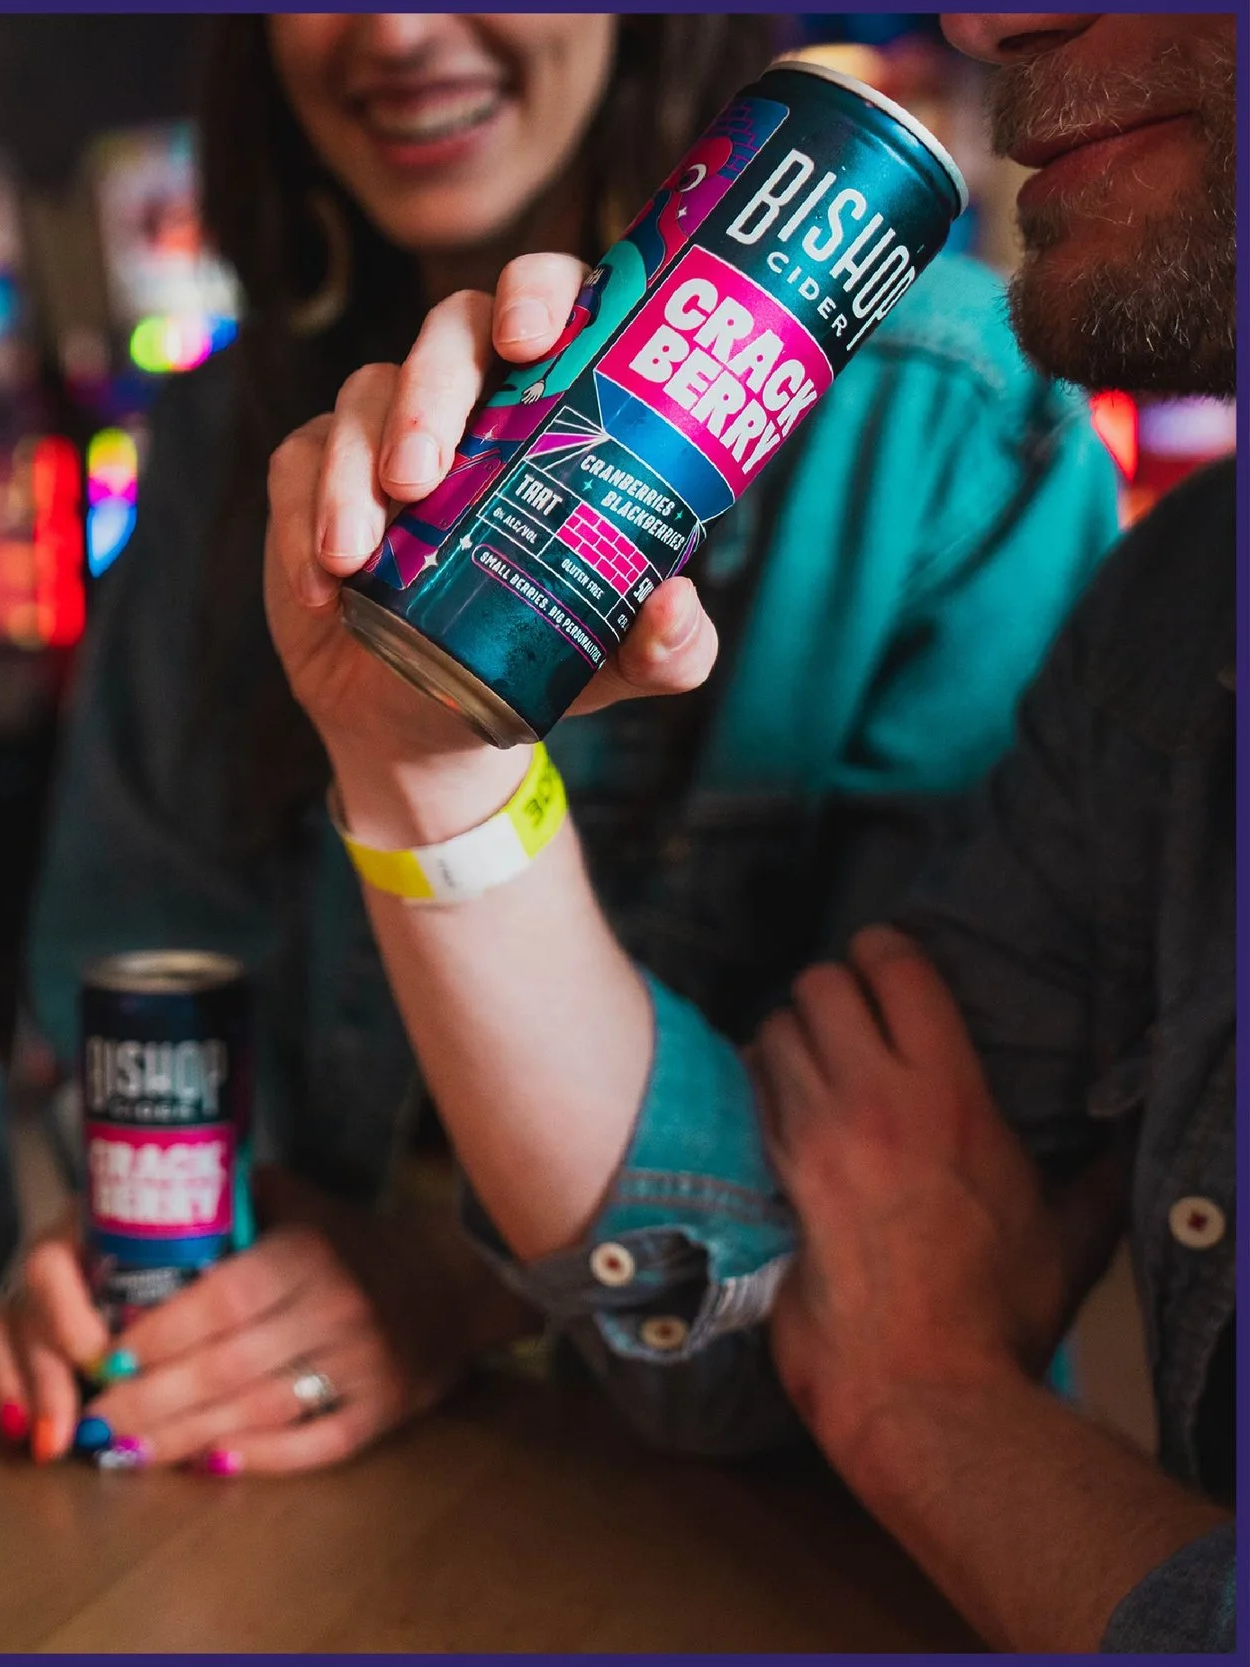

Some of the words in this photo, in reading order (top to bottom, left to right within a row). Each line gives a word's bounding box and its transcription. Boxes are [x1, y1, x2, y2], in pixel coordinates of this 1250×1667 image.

[726, 148, 916, 351] BISHOP
[766, 251, 848, 337] CIDER
[664, 278, 818, 437] CRACK
[628, 323, 781, 475] BERRY
[514, 473, 563, 516] TART
[580, 454, 676, 517] CRANBERRIES
[503, 514, 538, 544] ALC/VOL
[601, 490, 686, 551] BLACKBERRIES
[479, 551, 511, 580] SMALL
[509, 573, 549, 611] BERRIES.
[547, 605, 566, 624] BIG
[561, 558, 590, 586] GLUTEN
[586, 581, 606, 600] FREE
